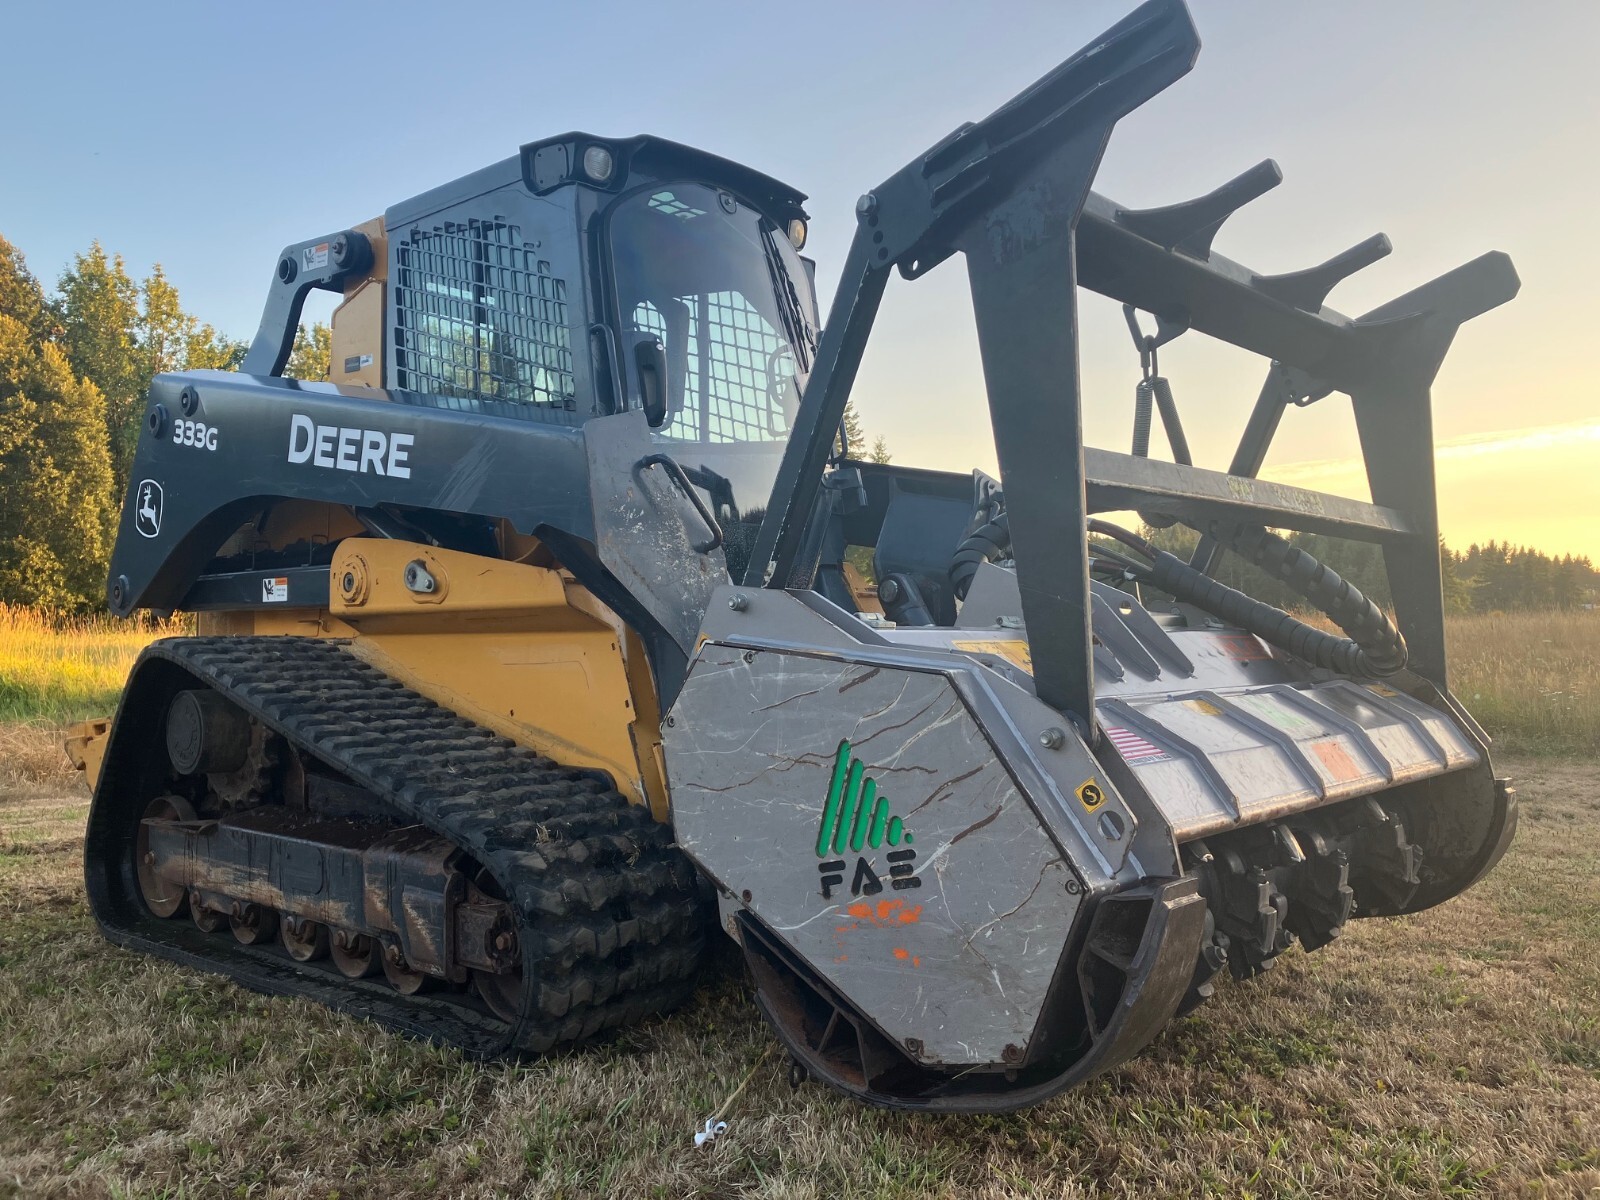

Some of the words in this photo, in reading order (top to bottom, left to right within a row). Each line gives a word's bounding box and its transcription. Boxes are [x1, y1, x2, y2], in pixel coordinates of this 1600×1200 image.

[173, 418, 218, 451] 333G
[288, 414, 414, 479] DEERE
[818, 849, 921, 900] FAE
